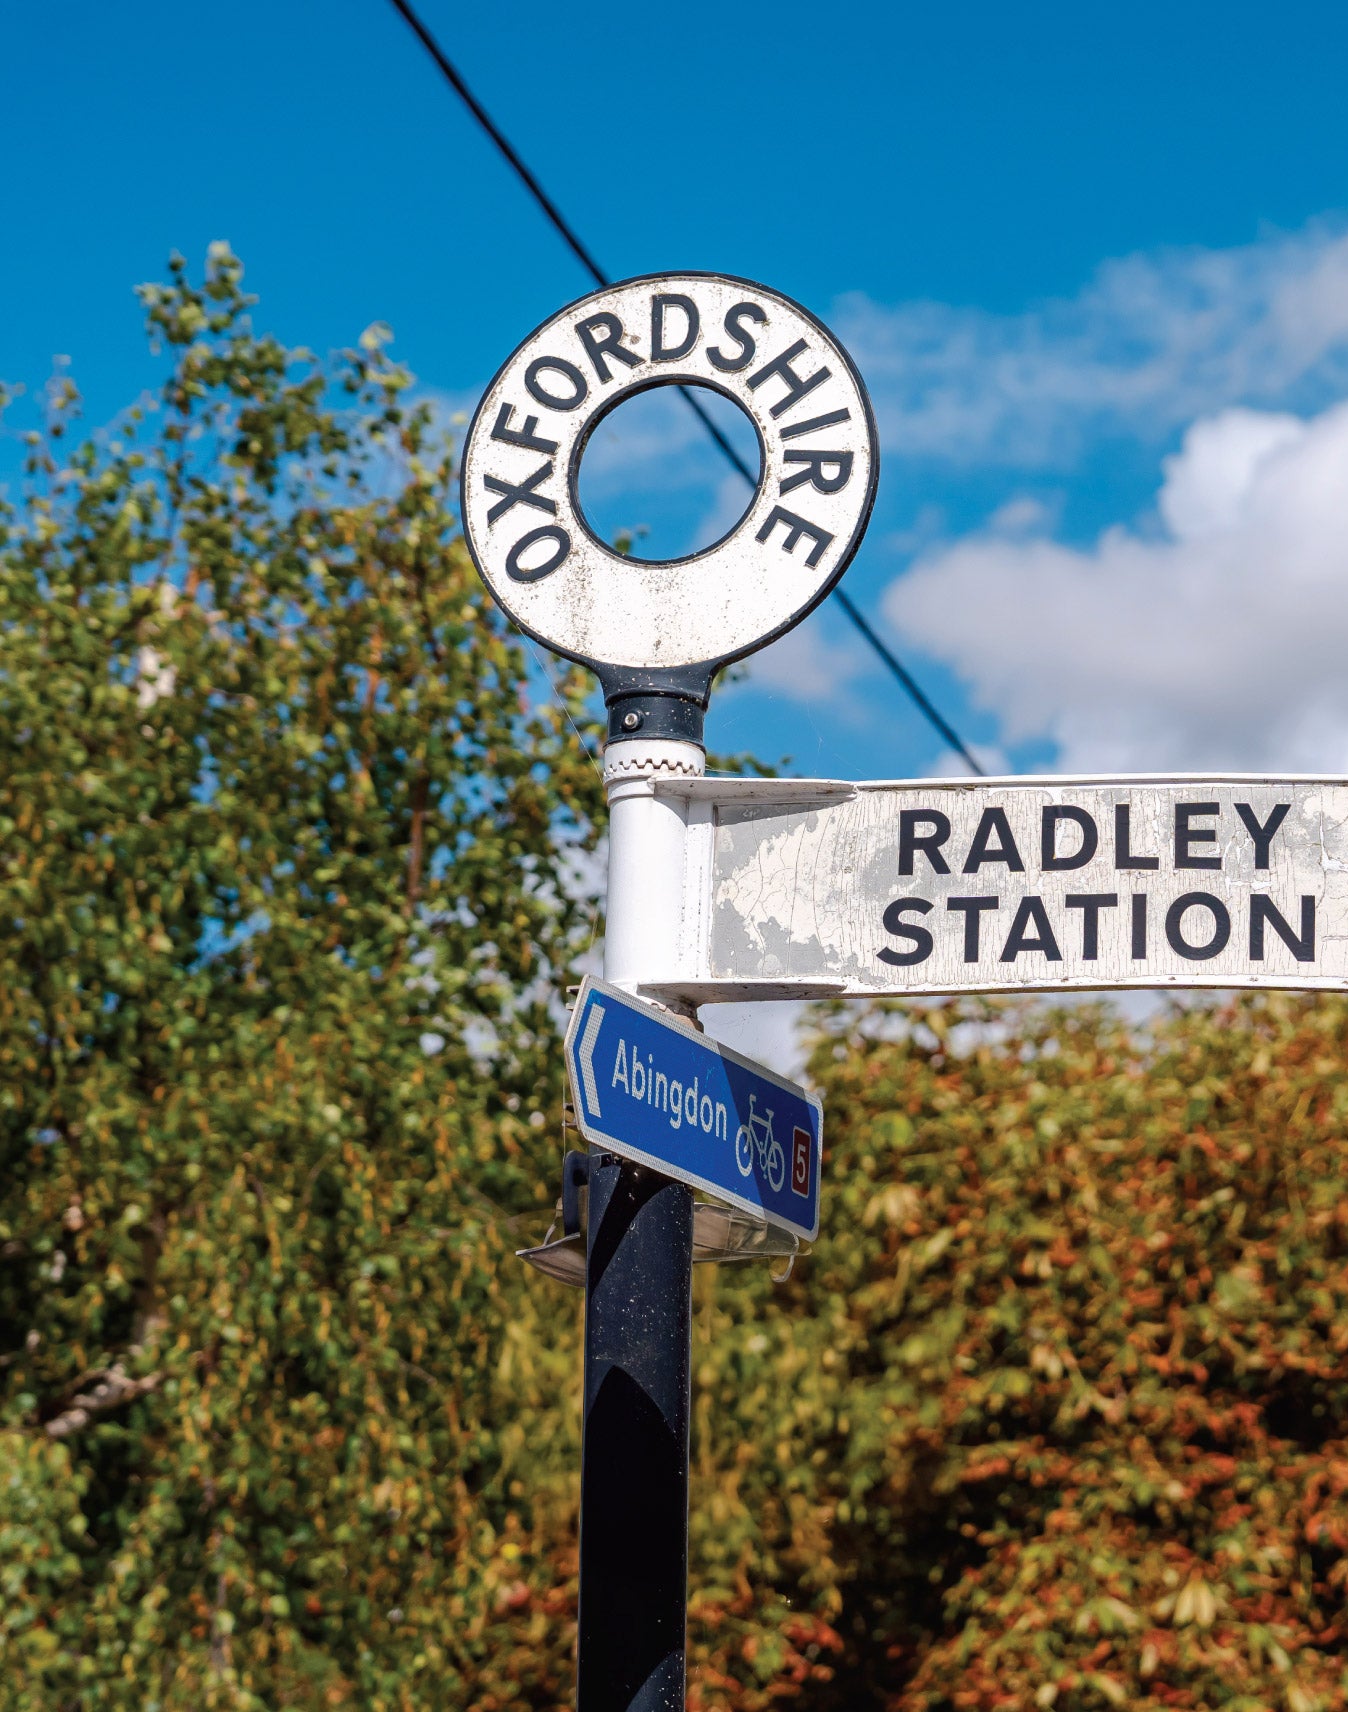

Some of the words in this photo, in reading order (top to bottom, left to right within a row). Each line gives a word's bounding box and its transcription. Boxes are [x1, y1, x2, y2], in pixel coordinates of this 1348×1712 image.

[483, 293, 853, 583] OXFORDSHIRE
[898, 802, 1291, 875] RADLEY
[876, 892, 1316, 966] STATION
[611, 1038, 728, 1141] Abingdon
[795, 1145, 807, 1184] 5
